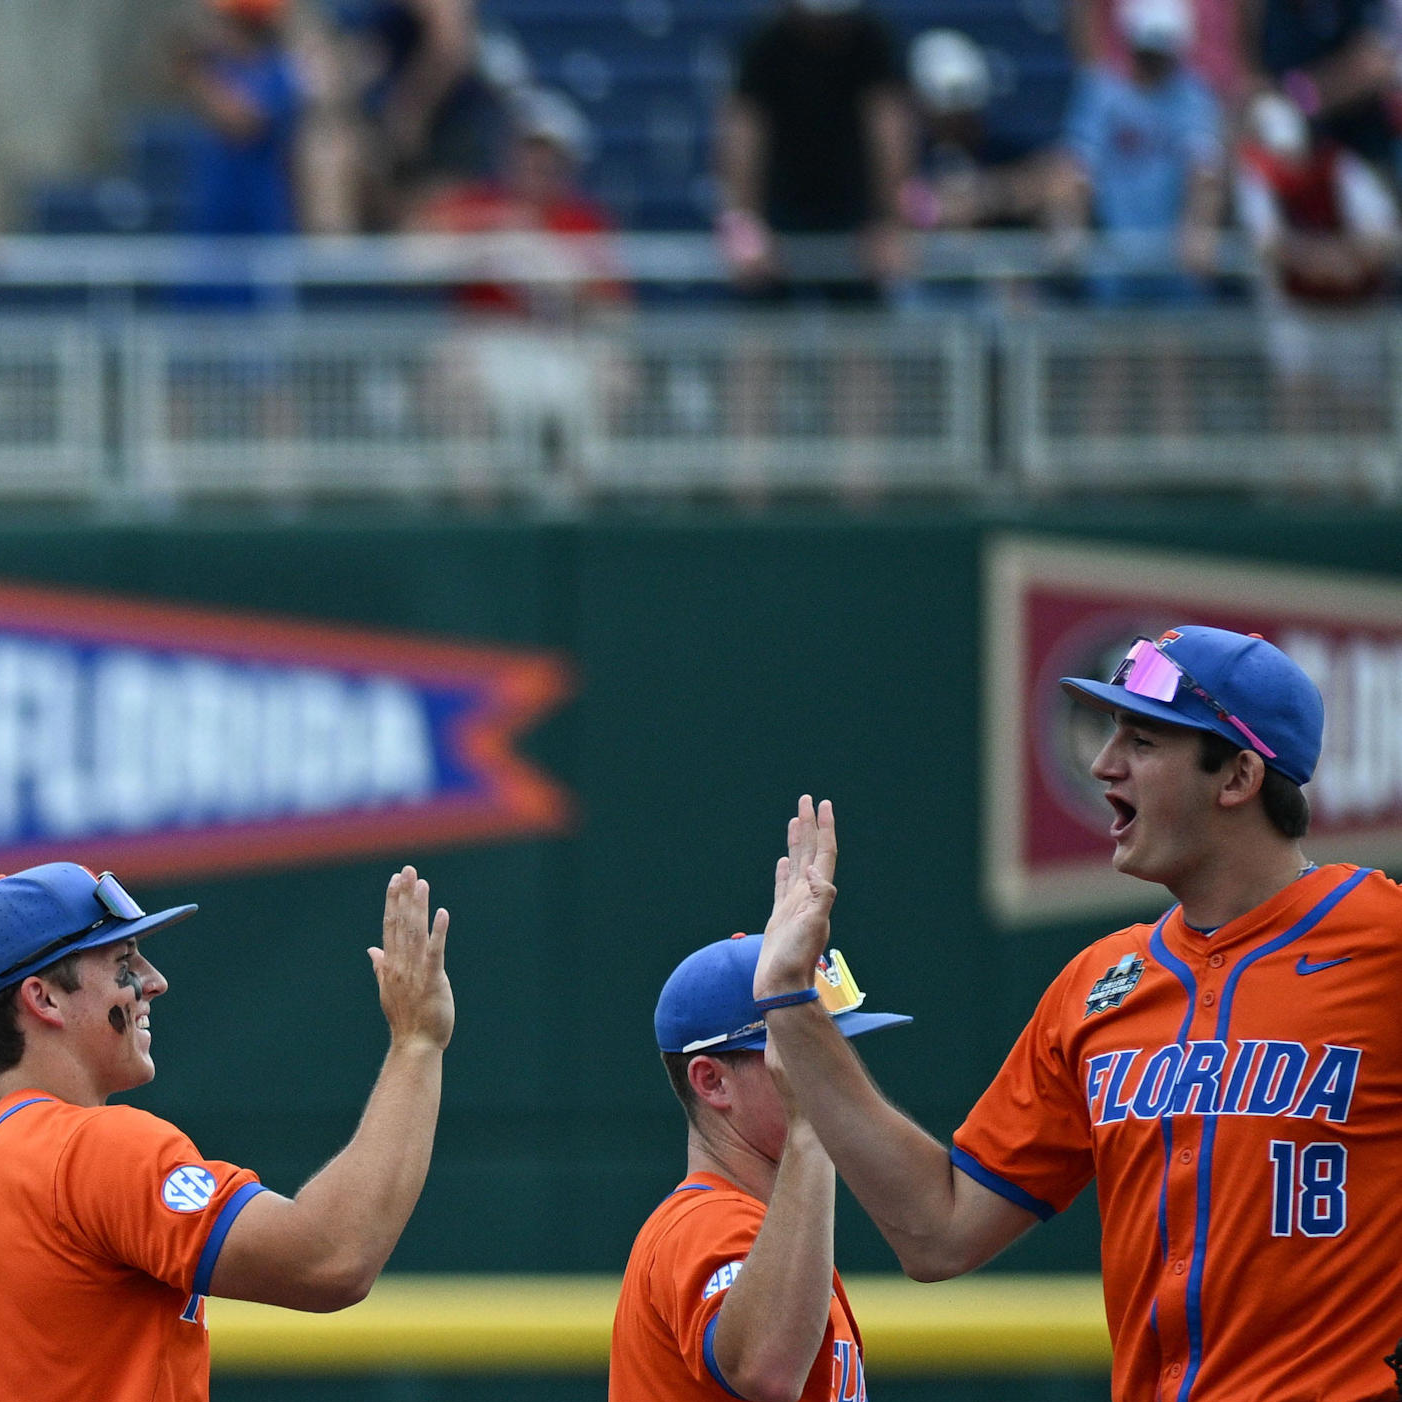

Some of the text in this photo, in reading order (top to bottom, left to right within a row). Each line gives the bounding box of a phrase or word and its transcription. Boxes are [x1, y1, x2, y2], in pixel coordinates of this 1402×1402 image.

[1085, 1039, 1363, 1126] FLORIDA
[164, 1166, 216, 1210] SEC
[1269, 1140, 1348, 1237] 18
